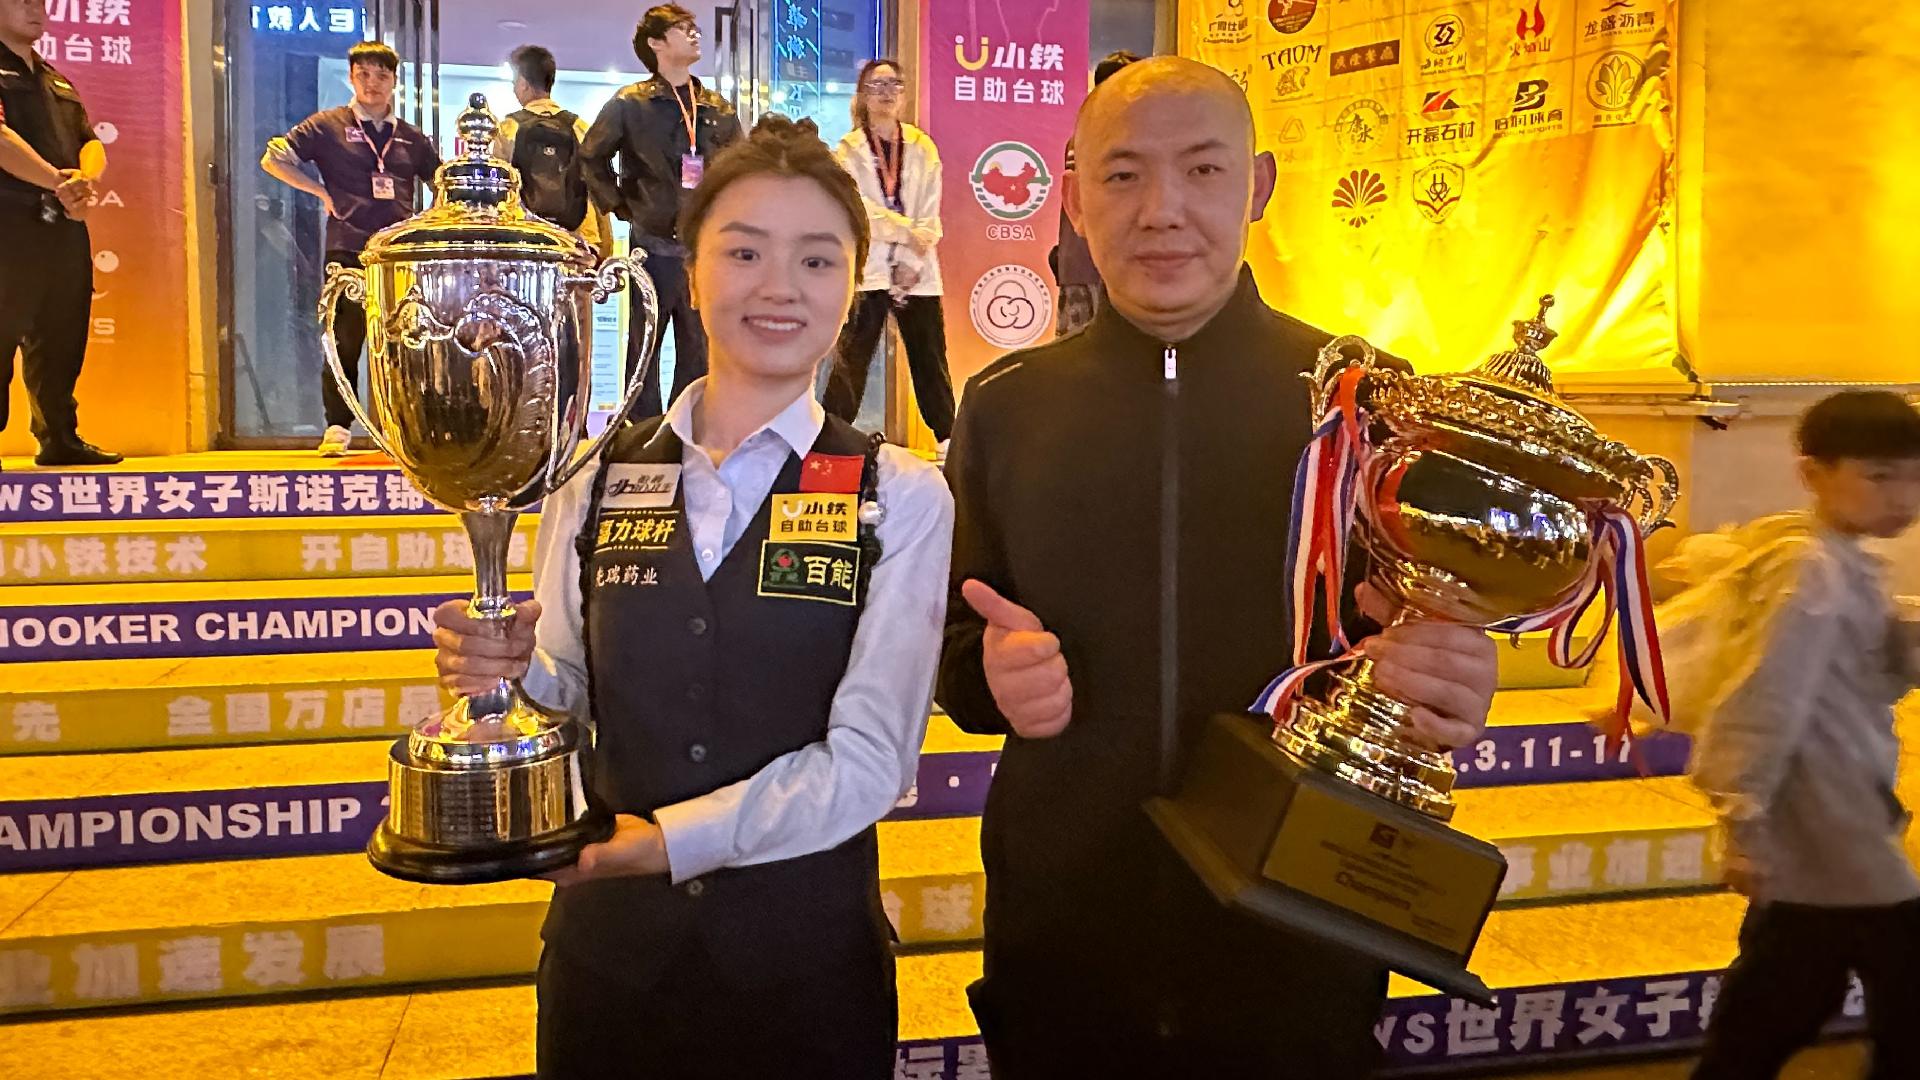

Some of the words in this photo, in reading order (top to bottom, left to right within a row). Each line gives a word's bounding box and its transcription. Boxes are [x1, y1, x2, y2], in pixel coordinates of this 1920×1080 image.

[992, 42, 1064, 70] 小铁
[955, 76, 1065, 105] 自助台球
[1407, 121, 1475, 145] 开磊石材
[986, 224, 1035, 240] CBSA
[804, 501, 848, 516] 小铁
[780, 520, 848, 533] 自助台球
[0, 535, 208, 578] 小铁技术
[804, 556, 853, 590] 百能
[195, 607, 437, 642] CHAMPION
[0, 796, 361, 850] AMPIONSHIP
